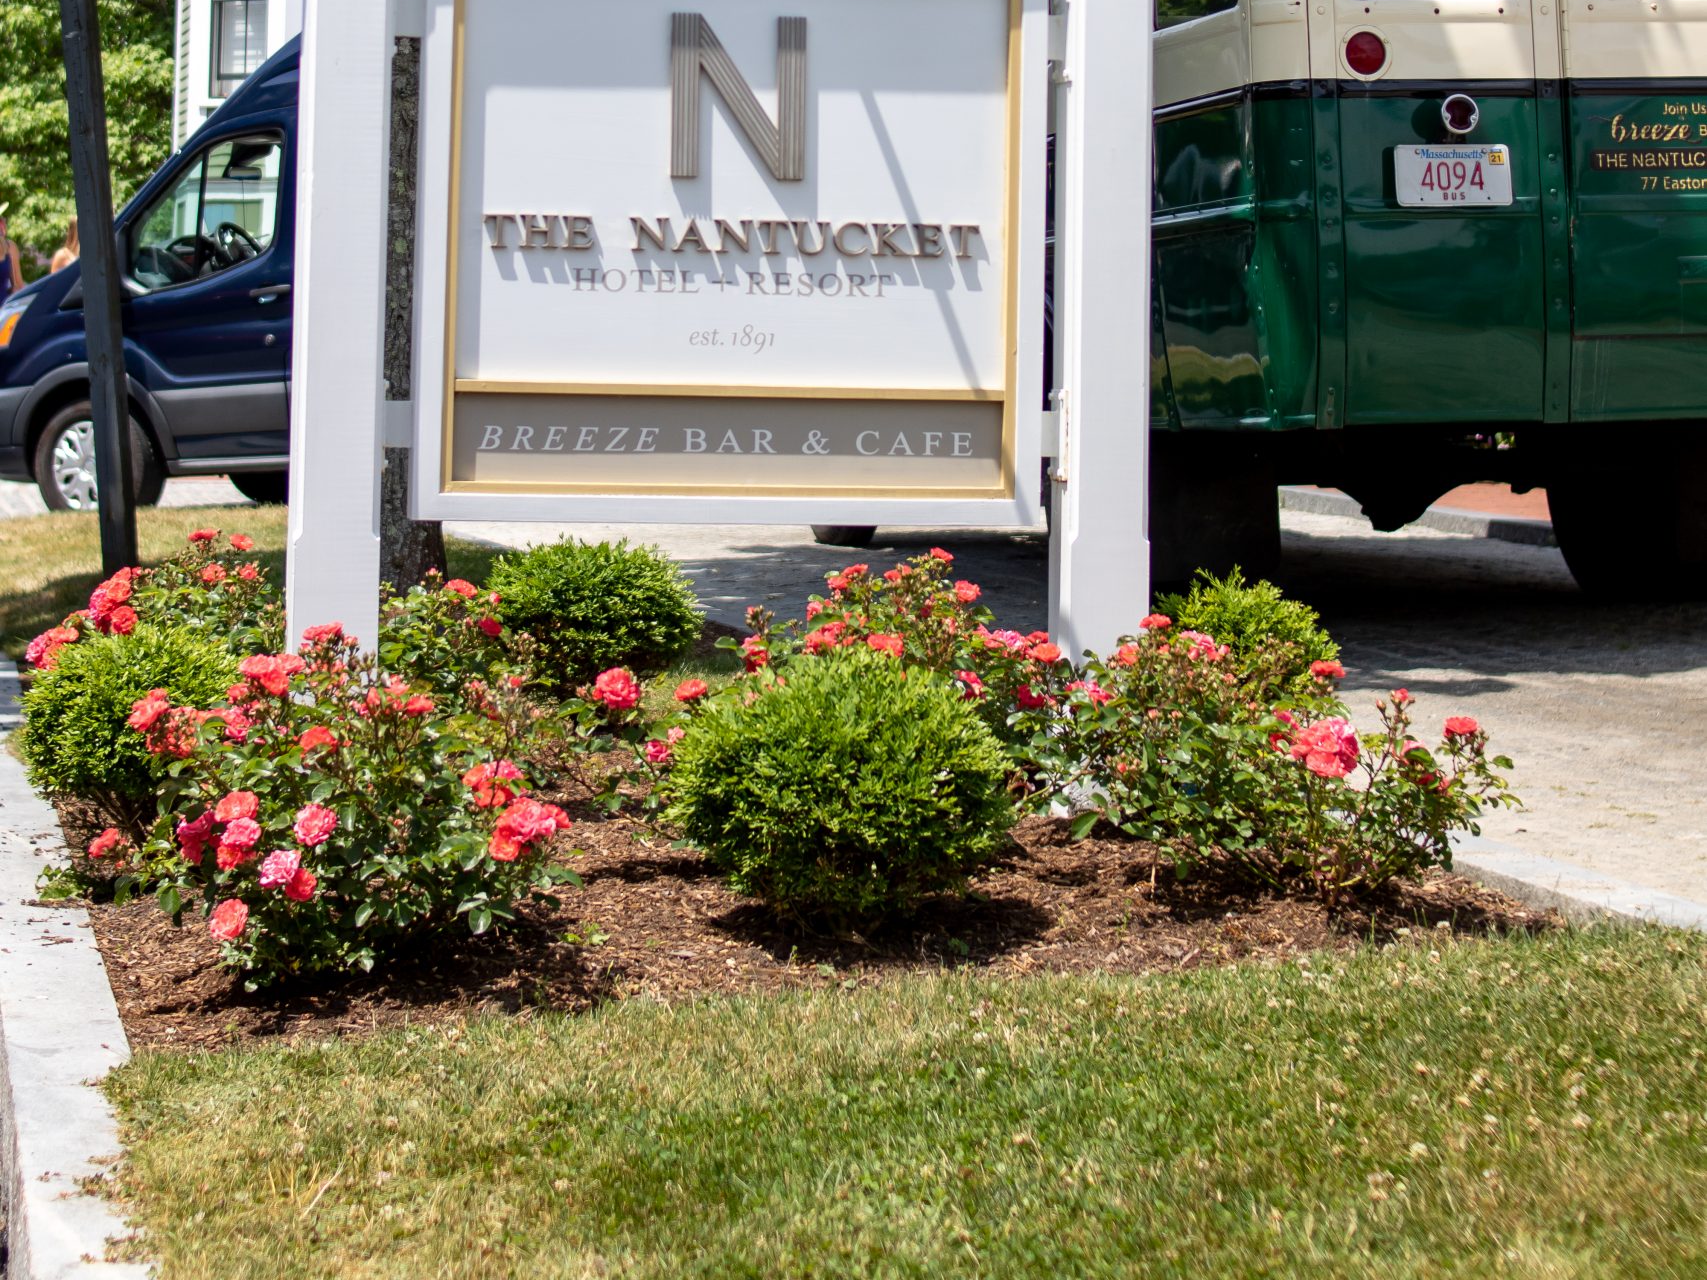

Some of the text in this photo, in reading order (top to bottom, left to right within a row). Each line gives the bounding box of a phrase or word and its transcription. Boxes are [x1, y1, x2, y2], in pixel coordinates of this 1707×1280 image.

[670, 12, 807, 181] N
[1663, 103, 1687, 115] Join
[1421, 149, 1483, 159] Massachusetts
[1491, 155, 1501, 163] 21
[1596, 153, 1628, 168] THE
[1421, 161, 1484, 191] 4094
[1641, 177, 1658, 190] 77
[1443, 192, 1466, 200] BUS
[485, 213, 981, 258] THE NANTUCKET
[573, 267, 892, 298] HOTEL + RESORT
[688, 326, 776, 354] est. 1891
[478, 426, 975, 458] BREEZE BAR & CAFE
